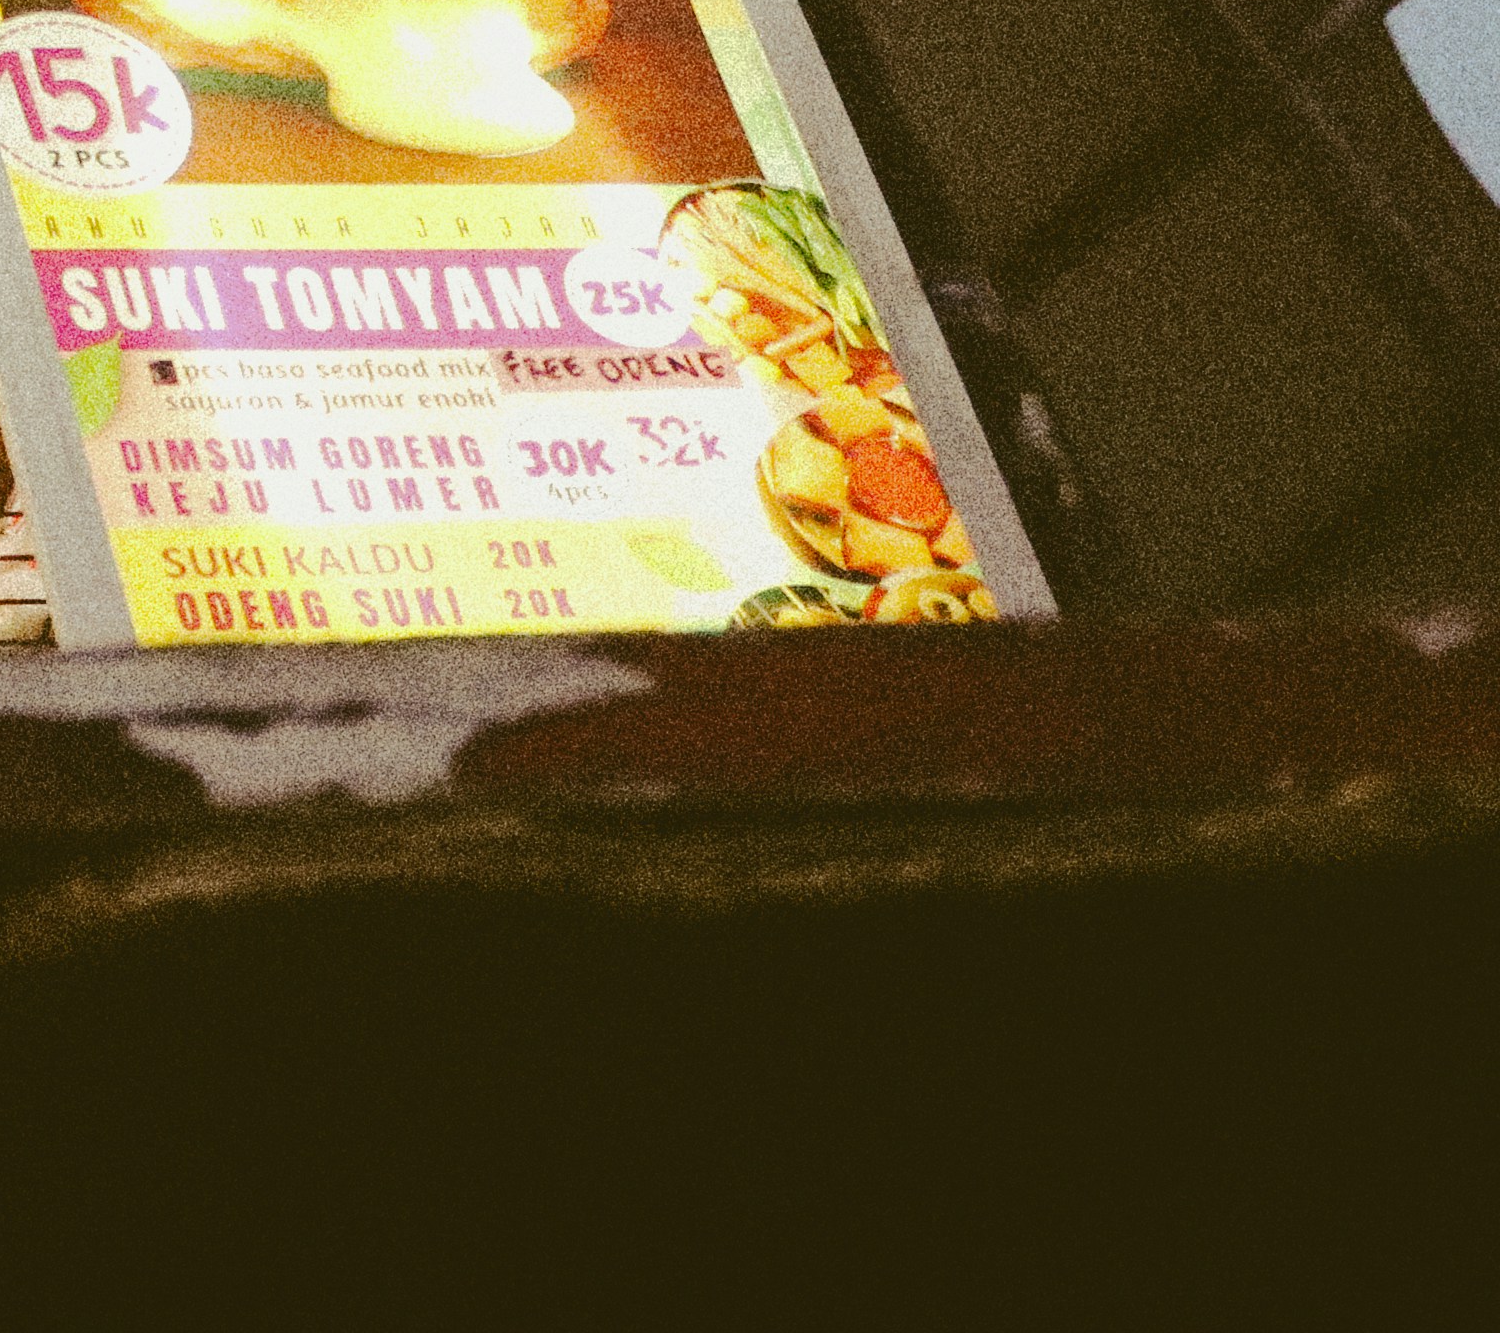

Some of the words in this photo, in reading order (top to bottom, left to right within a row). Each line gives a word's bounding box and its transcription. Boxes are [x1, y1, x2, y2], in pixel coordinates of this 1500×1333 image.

[48, 149, 63, 170] 2
[76, 147, 131, 171] PCS
[62, 265, 227, 334] SUKI
[244, 265, 564, 332] TOMYAM
[316, 357, 430, 384] seafood
[439, 357, 491, 379] mix
[295, 392, 313, 410] &
[322, 389, 404, 414] jamur
[120, 436, 296, 474] DIMSUM
[319, 434, 486, 471] GORENG
[130, 479, 269, 517] KEJU
[311, 475, 501, 513] LUMER
[161, 545, 269, 580] SUKI
[282, 543, 435, 578] KALDU
[174, 588, 329, 631] ODENG
[354, 585, 465, 628] SUKI
